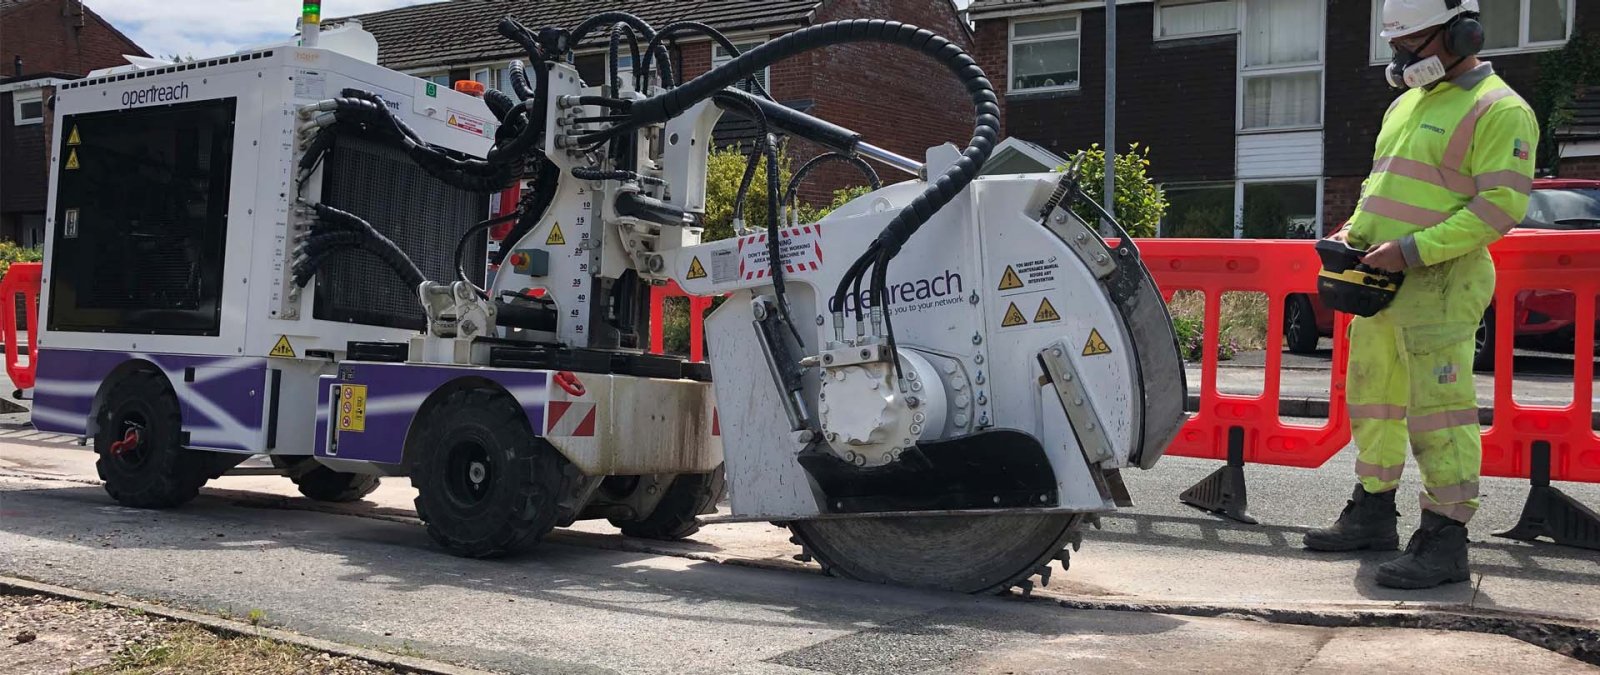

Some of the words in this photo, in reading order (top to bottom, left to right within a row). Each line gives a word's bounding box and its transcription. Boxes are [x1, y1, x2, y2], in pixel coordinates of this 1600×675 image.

[122, 81, 189, 109] openreach
[576, 216, 585, 224] 15
[790, 243, 810, 251] WORKING
[894, 305, 908, 315] you
[908, 303, 917, 312] to
[917, 301, 933, 312] your
[934, 295, 964, 308] network
